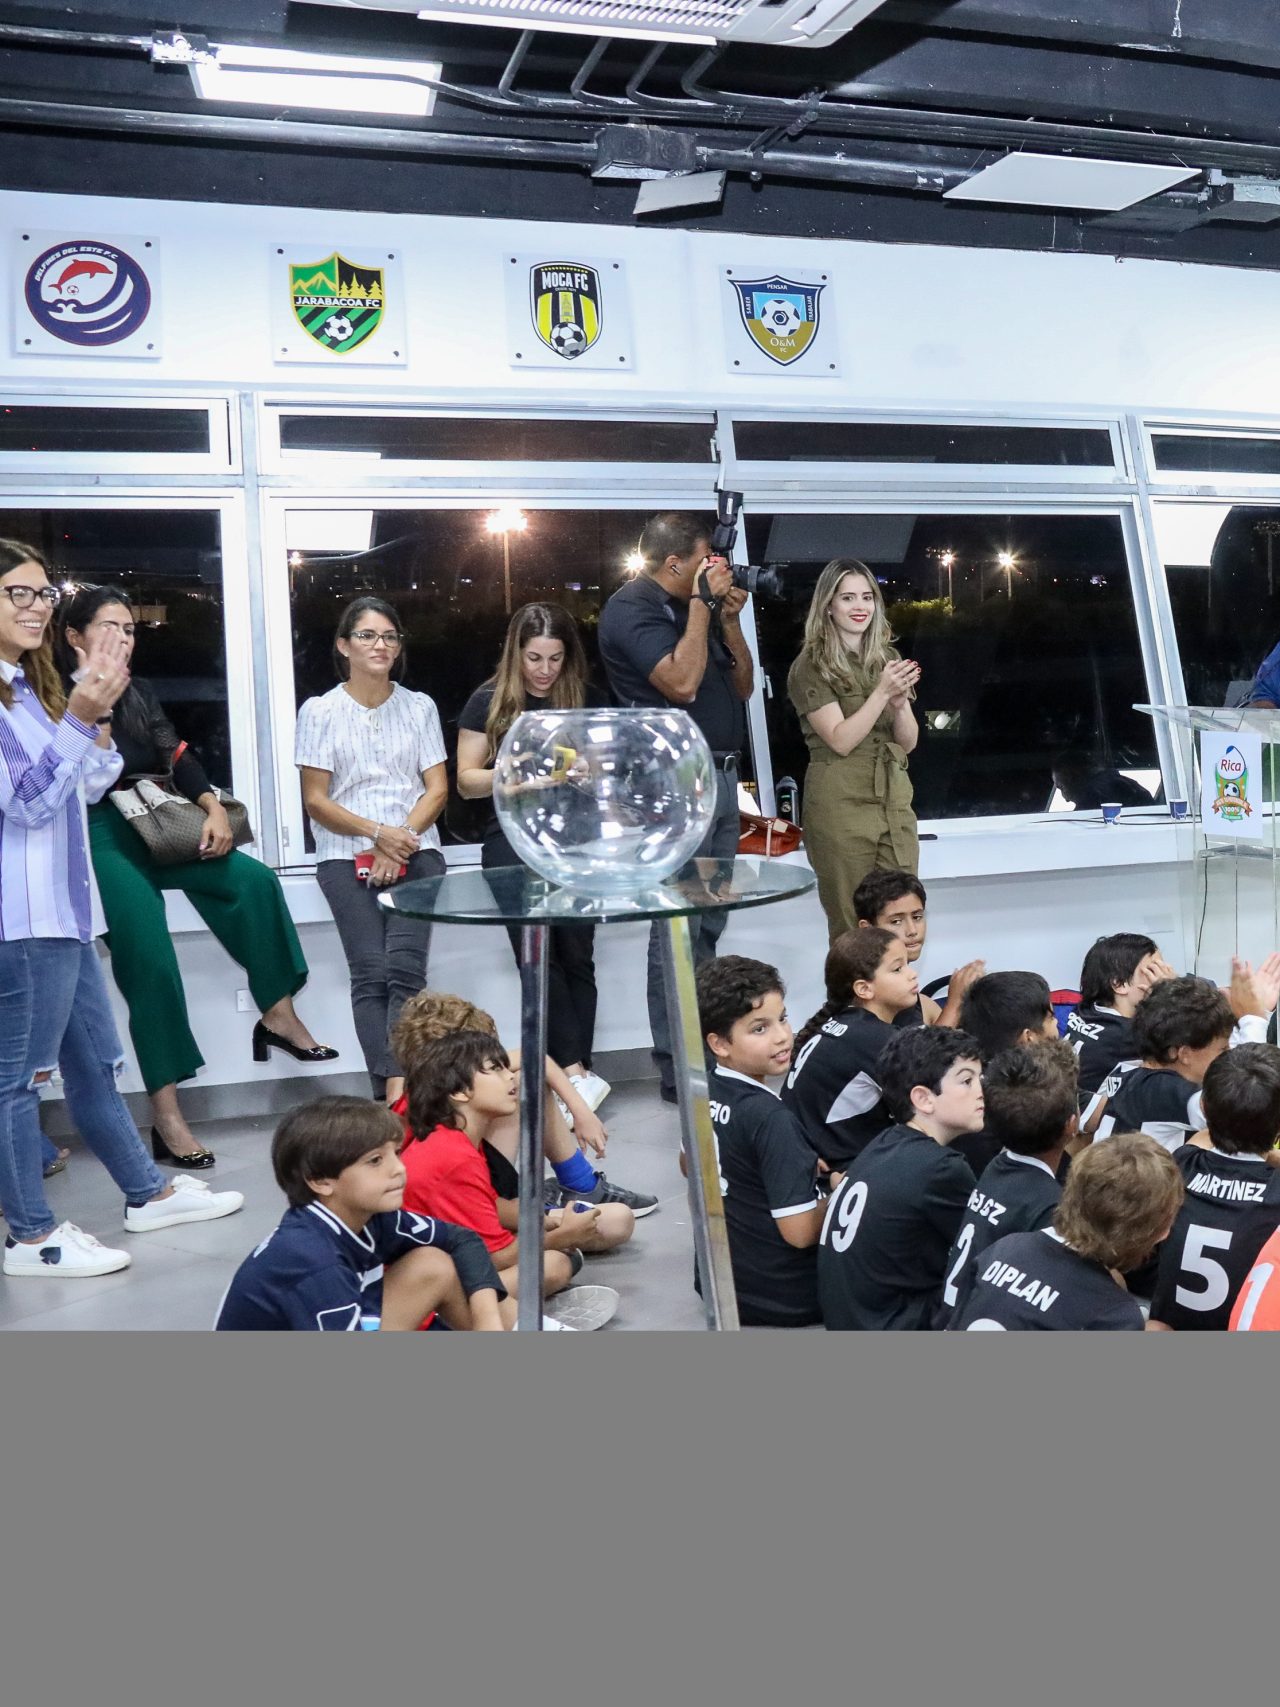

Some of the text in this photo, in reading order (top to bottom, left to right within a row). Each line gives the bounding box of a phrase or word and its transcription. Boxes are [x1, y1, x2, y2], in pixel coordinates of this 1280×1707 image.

[62, 247, 78, 255] DEL
[80, 246, 104, 254] ESTE
[541, 271, 589, 291] MOCA FC
[295, 296, 380, 307] JARABACOA FC
[770, 337, 796, 347] O&M
[1220, 758, 1242, 772] Rica
[1187, 1172, 1267, 1203] MARTINEZ
[819, 1174, 869, 1253] 19
[943, 1223, 975, 1307] 2
[1175, 1223, 1233, 1312] 5
[981, 1260, 1061, 1313] DIPLAN
[1236, 1262, 1275, 1331] 1
